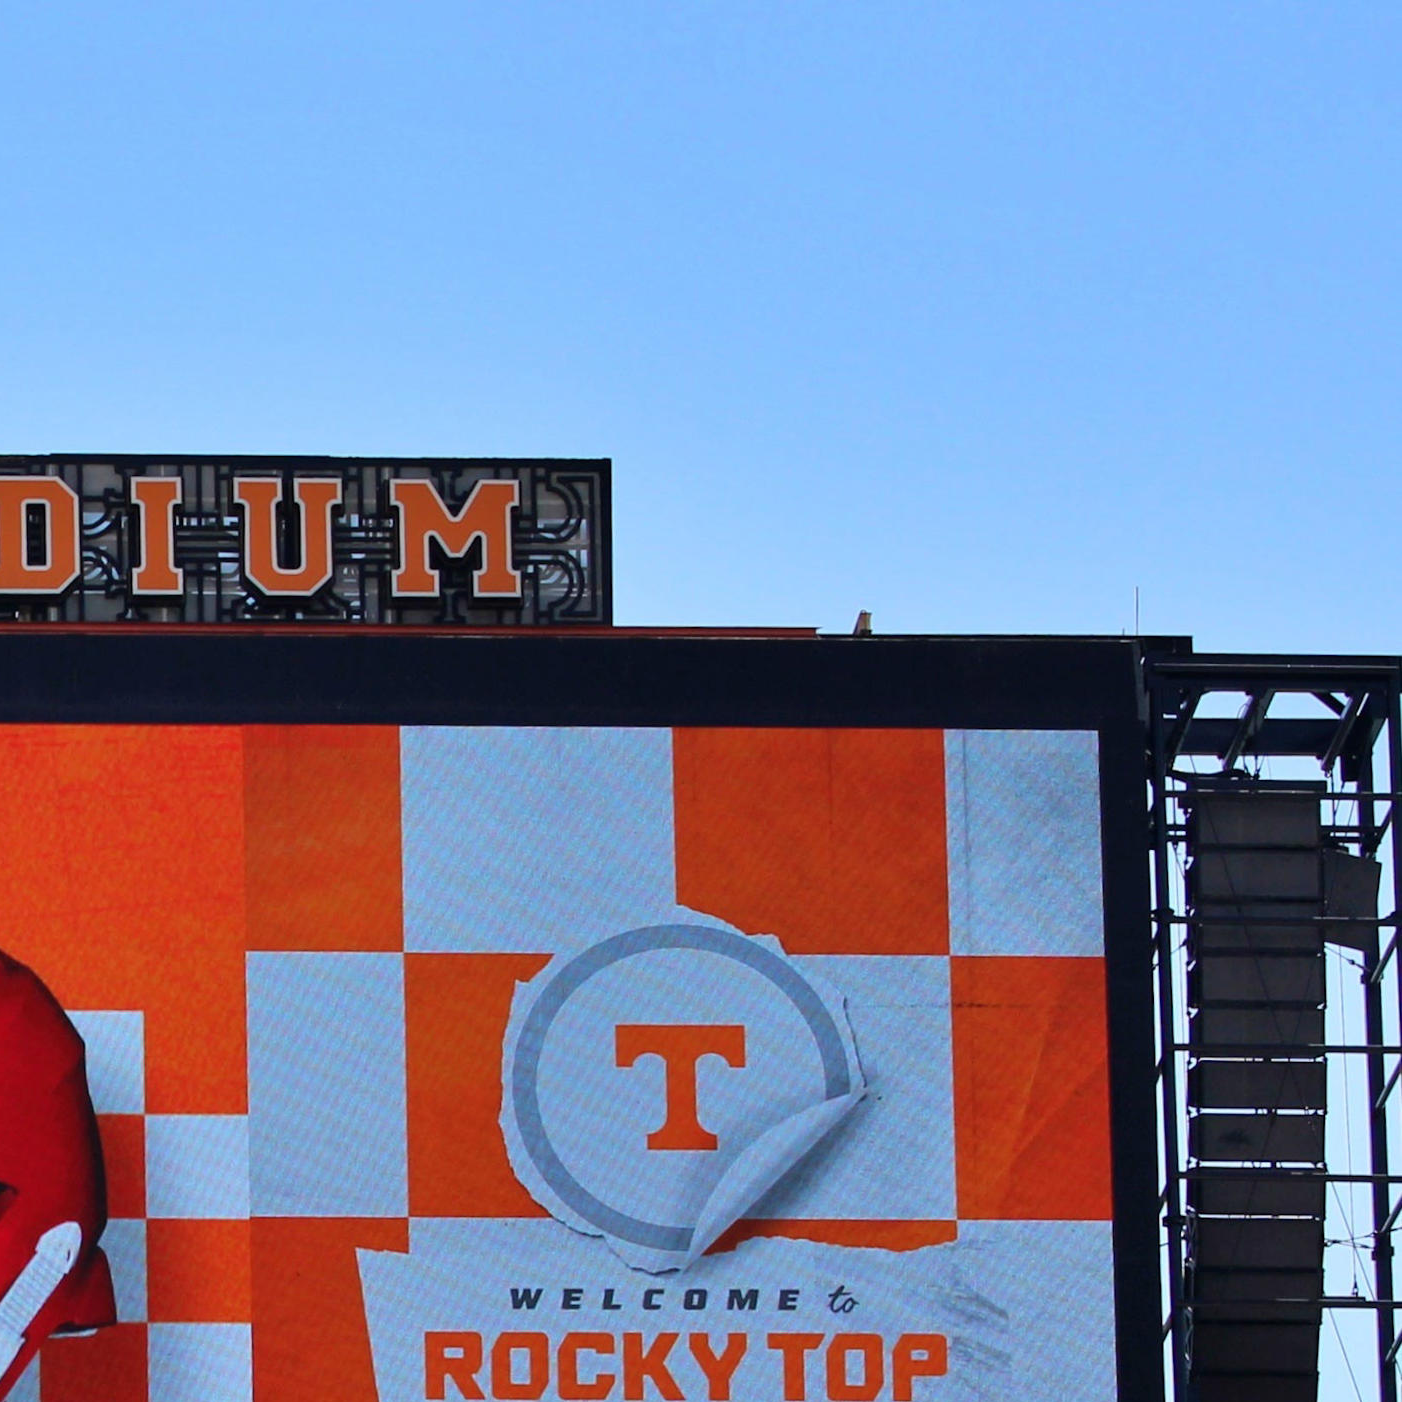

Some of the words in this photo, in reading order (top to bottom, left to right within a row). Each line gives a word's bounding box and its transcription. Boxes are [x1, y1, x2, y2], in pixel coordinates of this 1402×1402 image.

[614, 1024, 746, 1151] T
[509, 1288, 801, 1311] WELCOME
[828, 1285, 860, 1313] to
[424, 1331, 748, 1401] ROCKY
[767, 1333, 948, 1402] TOP
